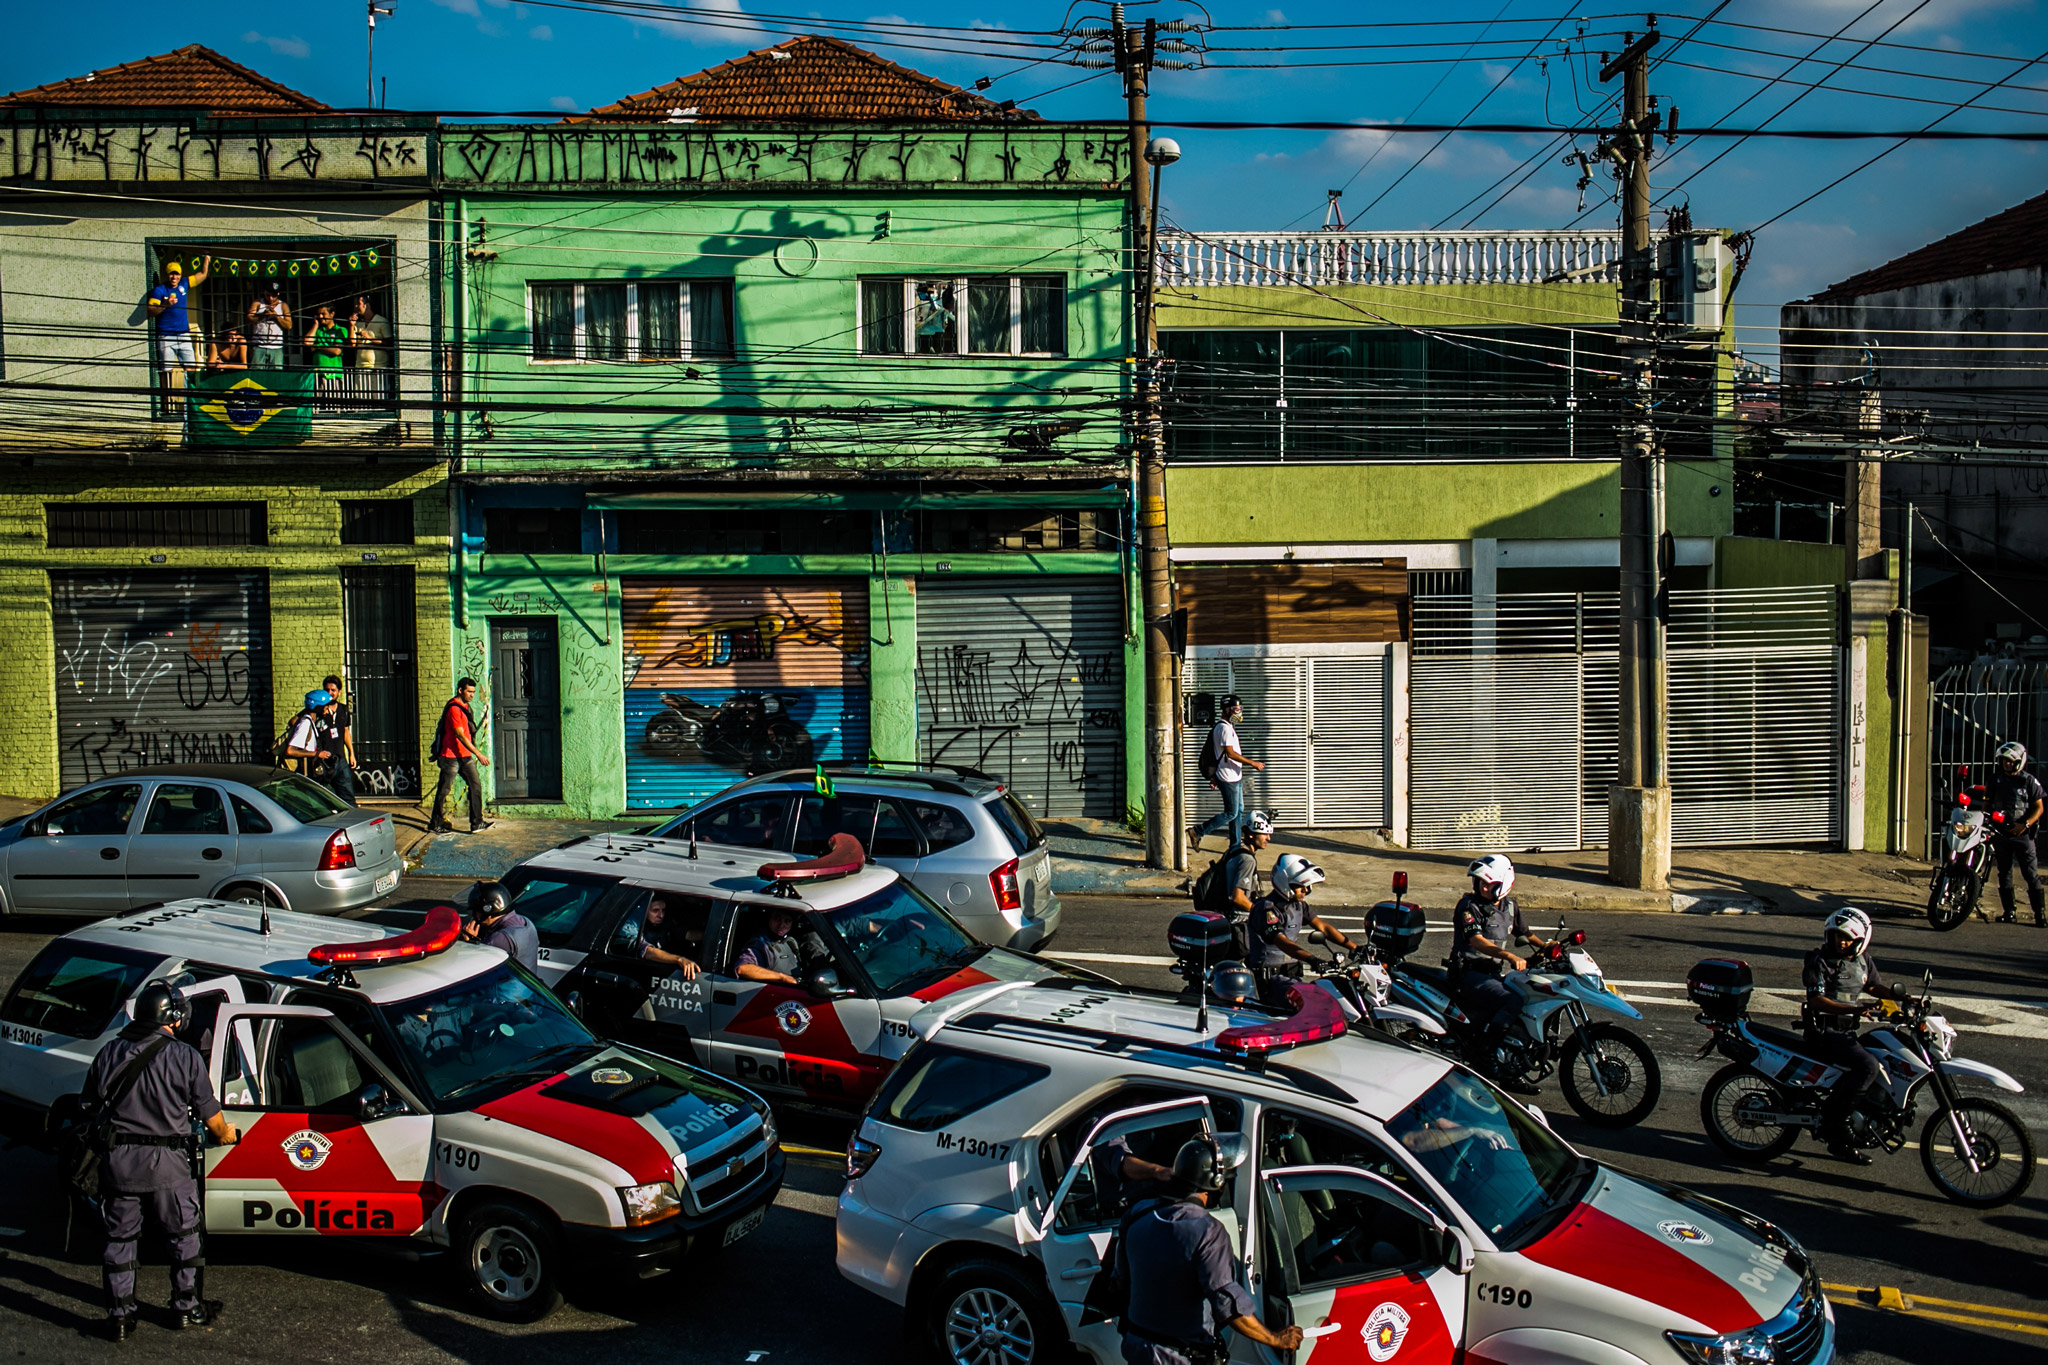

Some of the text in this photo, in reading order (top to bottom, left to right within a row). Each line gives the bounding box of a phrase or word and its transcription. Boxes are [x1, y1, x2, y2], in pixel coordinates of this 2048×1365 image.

[650, 977, 700, 996] FORÇA
[648, 994, 703, 1014] TÁTICA
[1, 1025, 43, 1047] M-13016
[735, 1054, 843, 1092] Polícia
[668, 1102, 739, 1143] Polícia
[1750, 1111, 1776, 1122] YAMAHA
[442, 1143, 480, 1172] 190
[936, 1131, 1011, 1162] M-13017
[242, 1199, 395, 1230] Polícia
[1735, 1242, 1789, 1294] Polícia
[1487, 1284, 1533, 1309] 190
